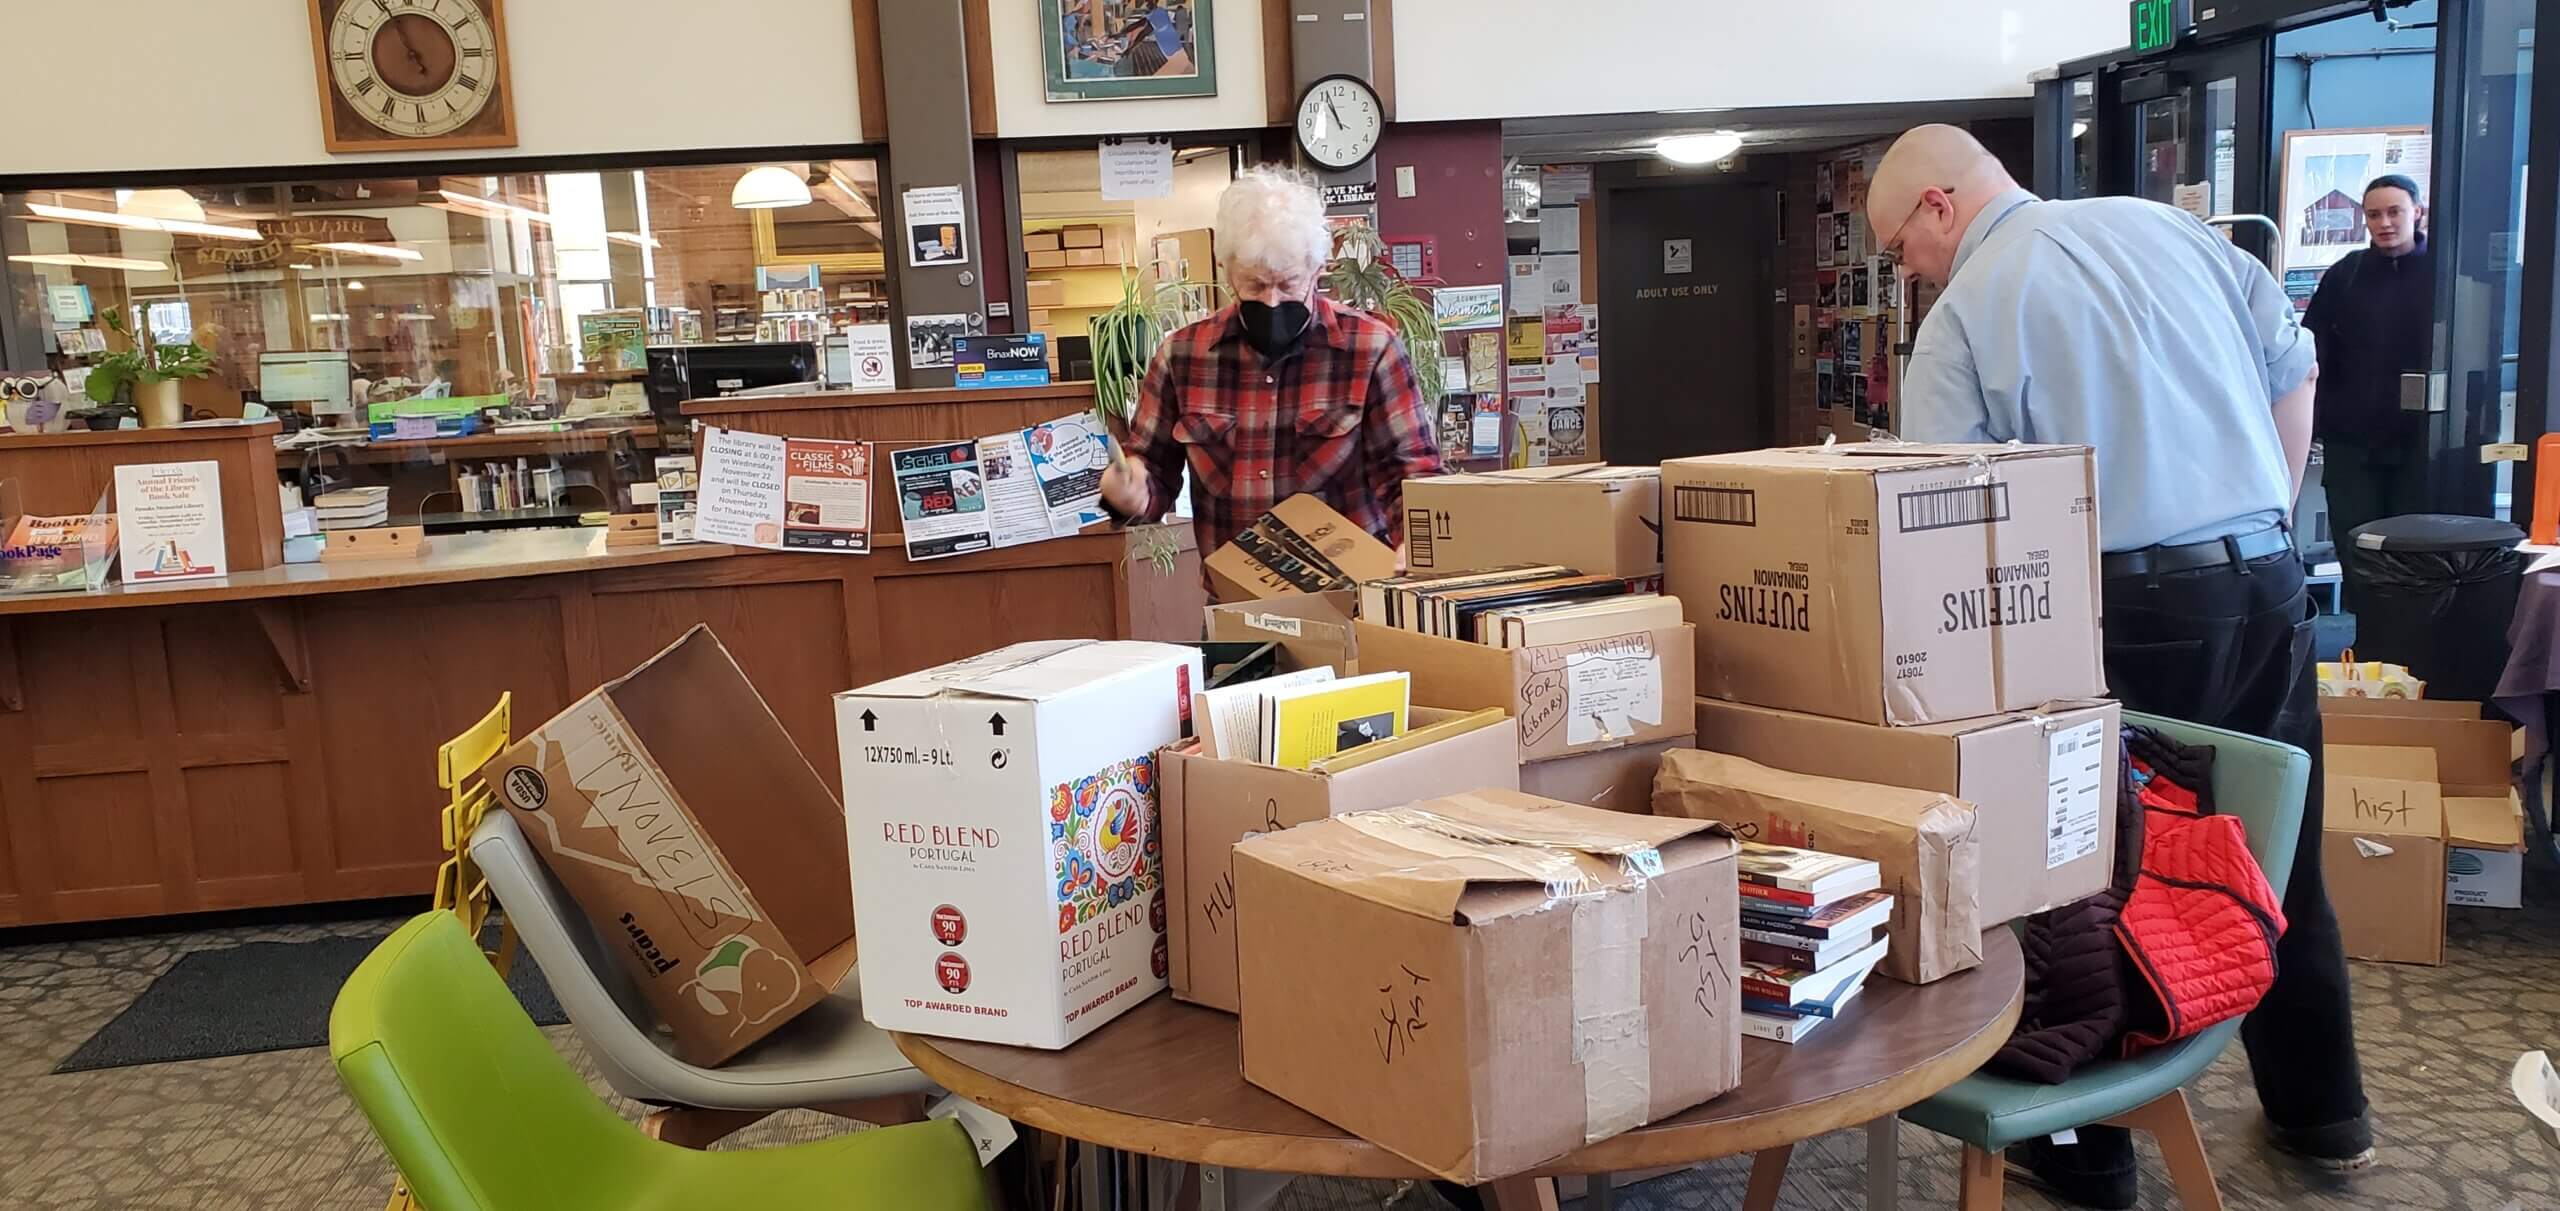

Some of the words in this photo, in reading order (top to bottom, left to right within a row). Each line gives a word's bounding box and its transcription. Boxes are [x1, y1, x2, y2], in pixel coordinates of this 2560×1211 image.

[2137, 0, 2172, 49] EXIT
[1333, 86, 1345, 97] 12
[1352, 91, 1357, 101] 1
[1308, 102, 1319, 113] 10
[1362, 102, 1369, 112] 2
[1306, 118, 1313, 129] 9
[1367, 117, 1374, 127] 3
[1362, 133, 1369, 144] 4
[1322, 145, 1329, 155] 7
[1336, 148, 1343, 160] 6
[1352, 144, 1358, 155] 5
[1348, 185, 1364, 194] MY
[1338, 192, 1376, 203] LIBRARY
[1636, 287, 1668, 299] ADULT
[1671, 286, 1689, 296] USE
[1693, 284, 1718, 295] ONLY
[1439, 300, 1494, 319] Vermont
[987, 347, 1040, 359] BinaxNOW
[1551, 419, 1582, 431] DANCE
[718, 437, 732, 445] The
[733, 438, 756, 449] library
[758, 441, 771, 450] will
[772, 443, 781, 451] be
[710, 446, 743, 457] CLOSING
[790, 452, 834, 462] CLASSIC
[732, 458, 774, 471] Wednesday,
[803, 461, 834, 470] FILMS
[722, 467, 760, 478] November
[762, 472, 771, 480] 22
[165, 484, 196, 493] Library
[711, 476, 725, 484] and
[726, 477, 739, 485] will
[741, 479, 750, 487] be
[751, 481, 781, 491] CLOSED
[711, 504, 721, 513] for
[718, 496, 757, 507] November
[758, 501, 768, 509] 23
[0, 544, 62, 560] ookPage
[2027, 550, 2049, 560] CEREAL
[1788, 561, 1809, 572] CEREAL
[1985, 561, 2049, 585] CINNAMON
[1753, 568, 1809, 591] CINNAMON
[1719, 583, 1811, 633] PUFFINS
[1943, 580, 2051, 633] PUFFINS
[1536, 648, 1565, 666] ALL
[1896, 652, 1927, 666] 20610
[1896, 665, 1924, 679] 70617
[1525, 677, 1557, 701] FOR
[864, 746, 903, 764] 12X750
[905, 746, 921, 765] ml.
[931, 748, 938, 765] 9
[940, 748, 954, 766] Lt.
[510, 777, 534, 805] USDA
[2352, 787, 2416, 827] hist
[883, 822, 926, 844] RED
[932, 825, 1000, 848] BLEND
[910, 847, 976, 863] PORTUGAL
[1203, 798, 1287, 934] HUR
[942, 920, 956, 933] 90
[1060, 929, 1093, 963] RED
[1097, 903, 1144, 944] BLEND
[1062, 946, 1111, 982] PORTUGAL
[946, 968, 960, 980] 90
[1064, 1009, 1080, 1024] TOP
[1081, 990, 1115, 1017] AWARDED
[1115, 976, 1138, 996] BRAND
[904, 999, 923, 1008] TOP
[925, 1001, 972, 1014] AWARDED
[974, 1006, 1008, 1018] BRAND
